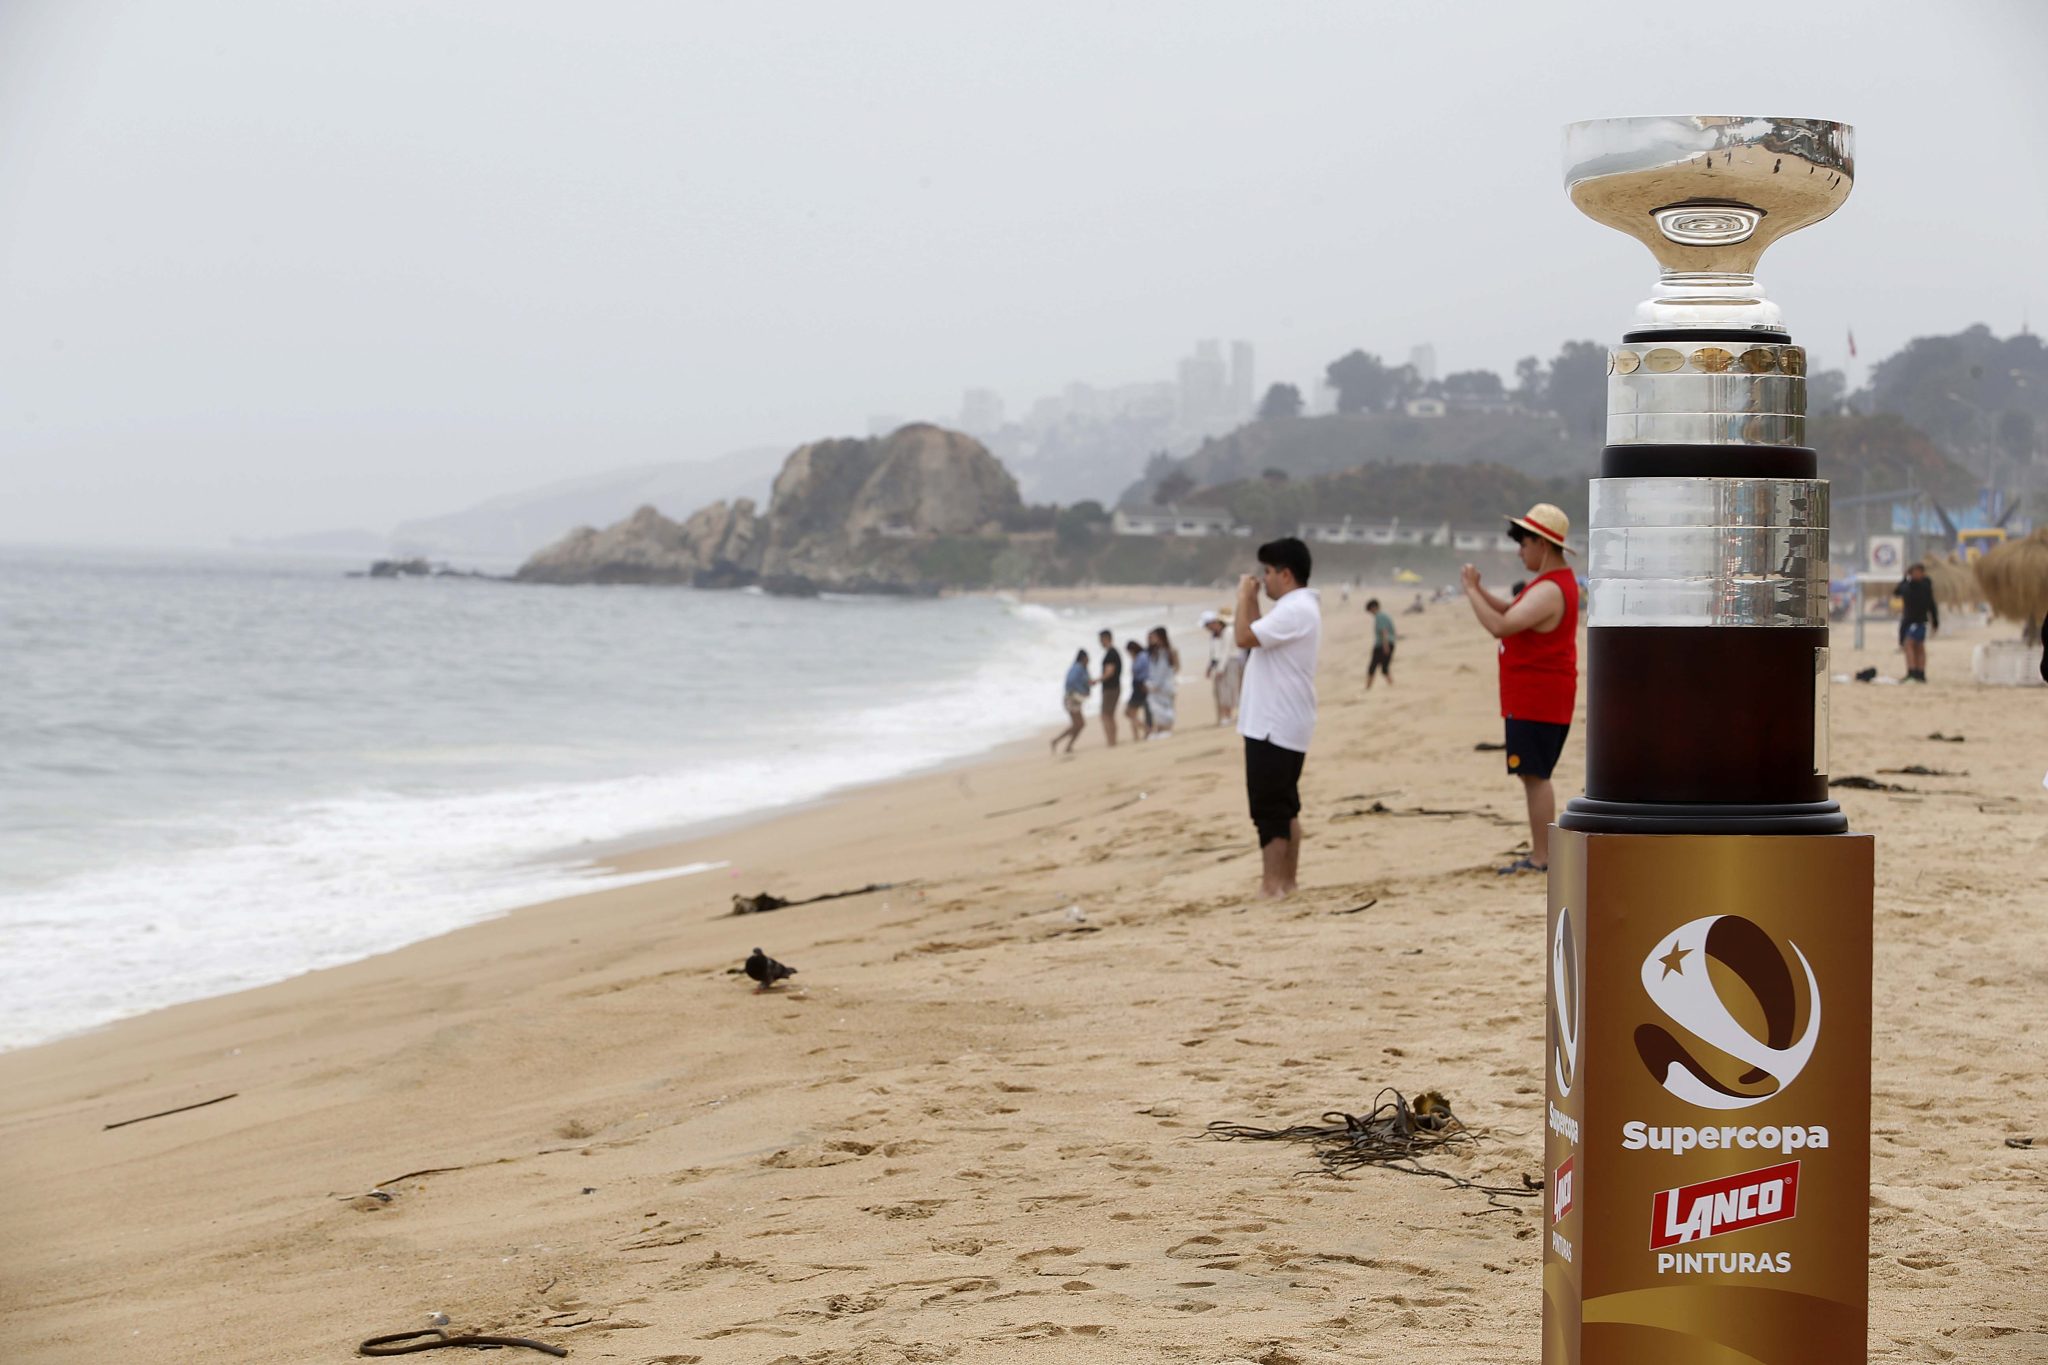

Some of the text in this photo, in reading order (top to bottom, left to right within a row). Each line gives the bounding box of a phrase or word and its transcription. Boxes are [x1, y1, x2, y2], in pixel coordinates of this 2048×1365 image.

[1549, 1100, 1579, 1146] Supercopa
[1621, 1120, 1829, 1155] Supercopa
[1664, 1178, 1784, 1244] LANCO
[1657, 1252, 1792, 1274] PINTURAS
